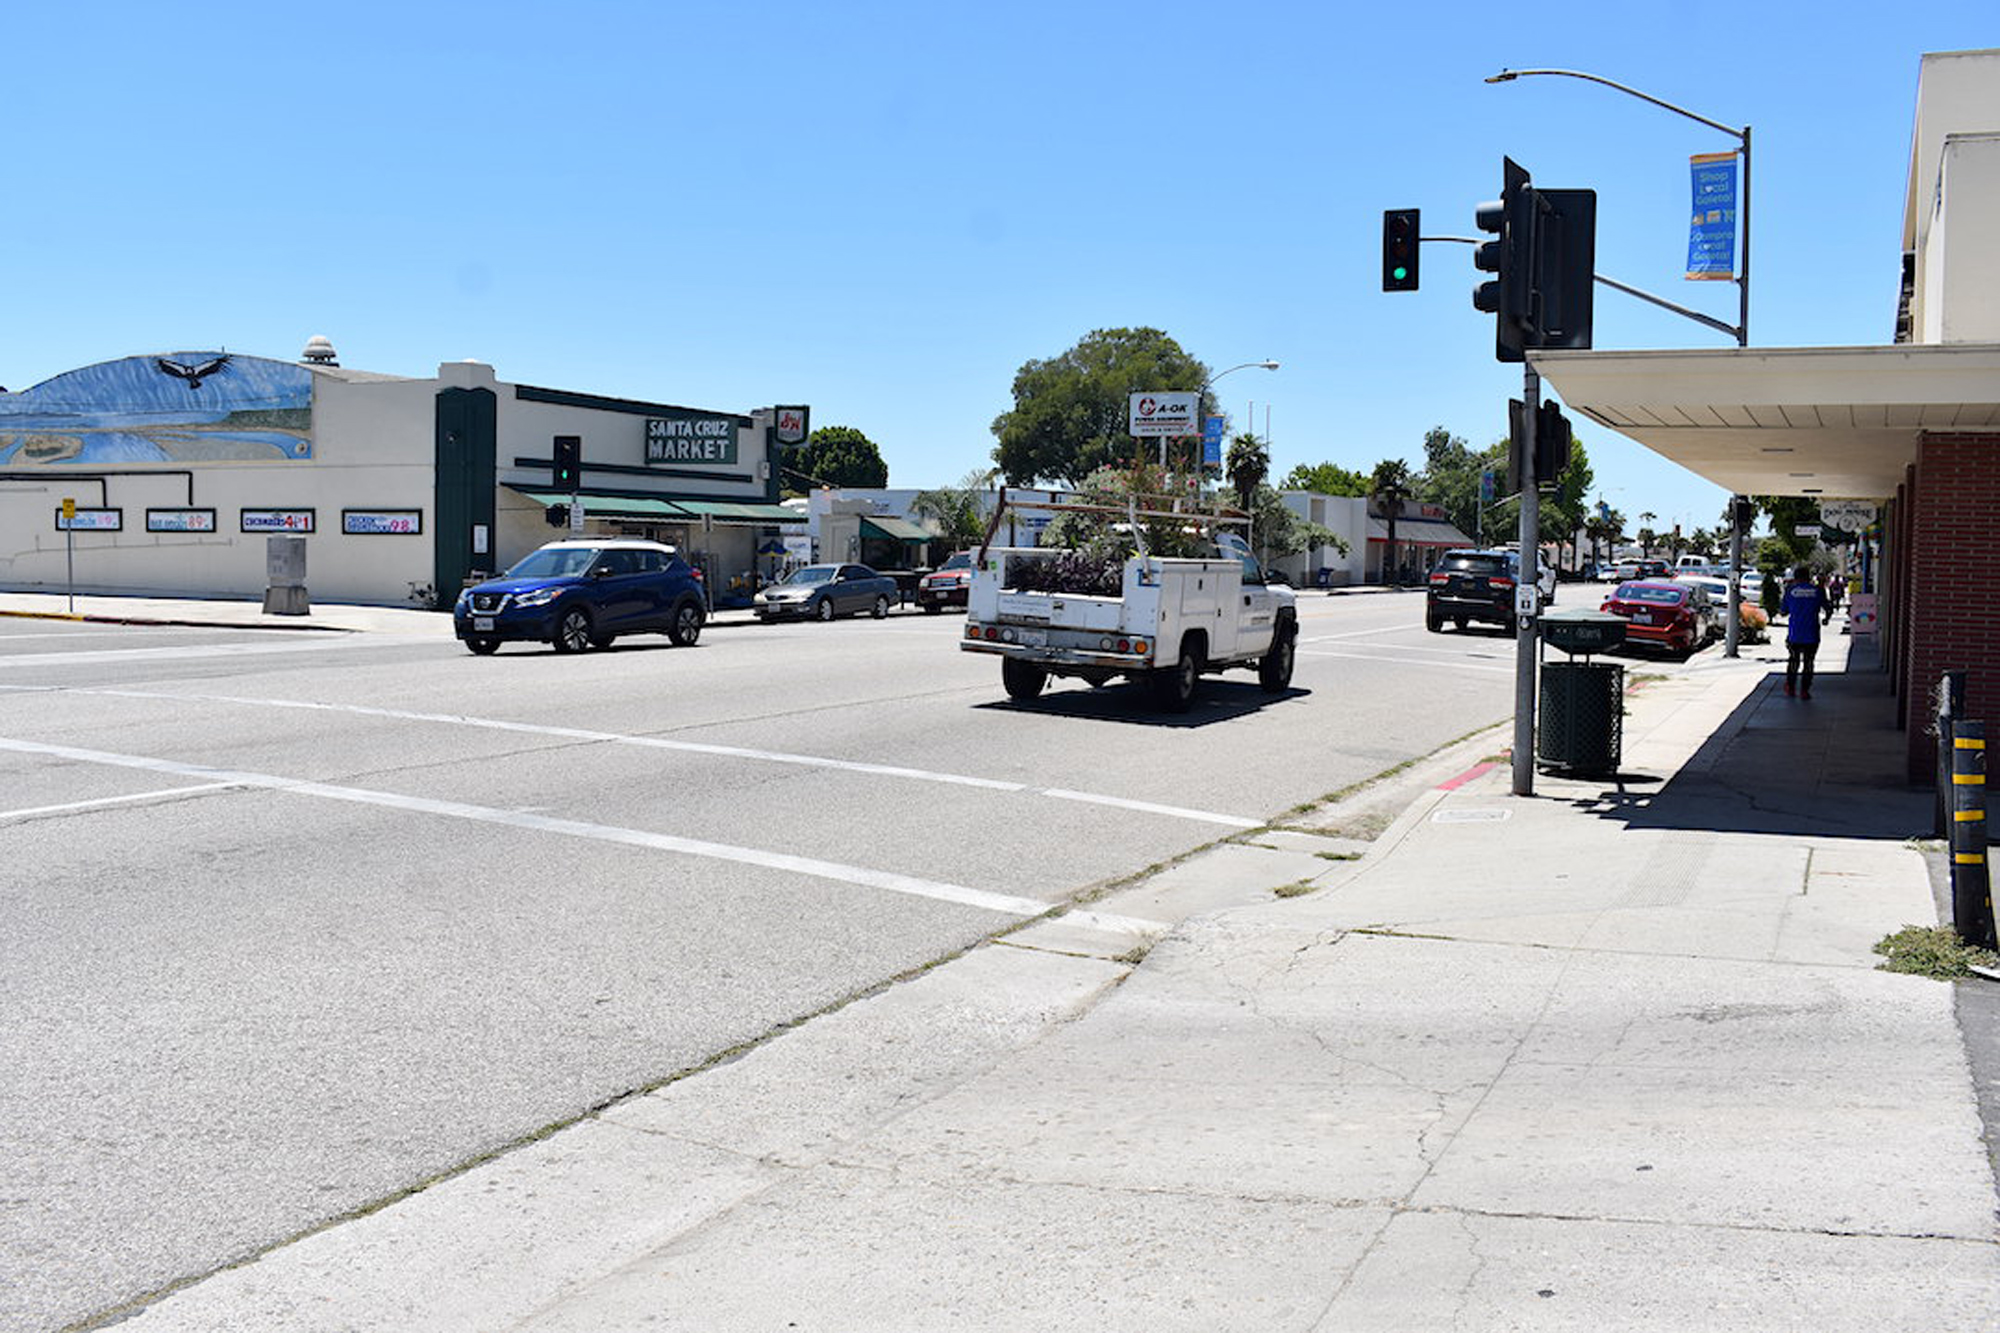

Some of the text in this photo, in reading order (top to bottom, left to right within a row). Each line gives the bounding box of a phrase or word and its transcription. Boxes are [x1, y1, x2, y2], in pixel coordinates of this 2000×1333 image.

[649, 421, 730, 437] SANTA CRUZ
[648, 439, 730, 459] MARKET
[285, 515, 293, 528] 4
[390, 519, 410, 533] 98
